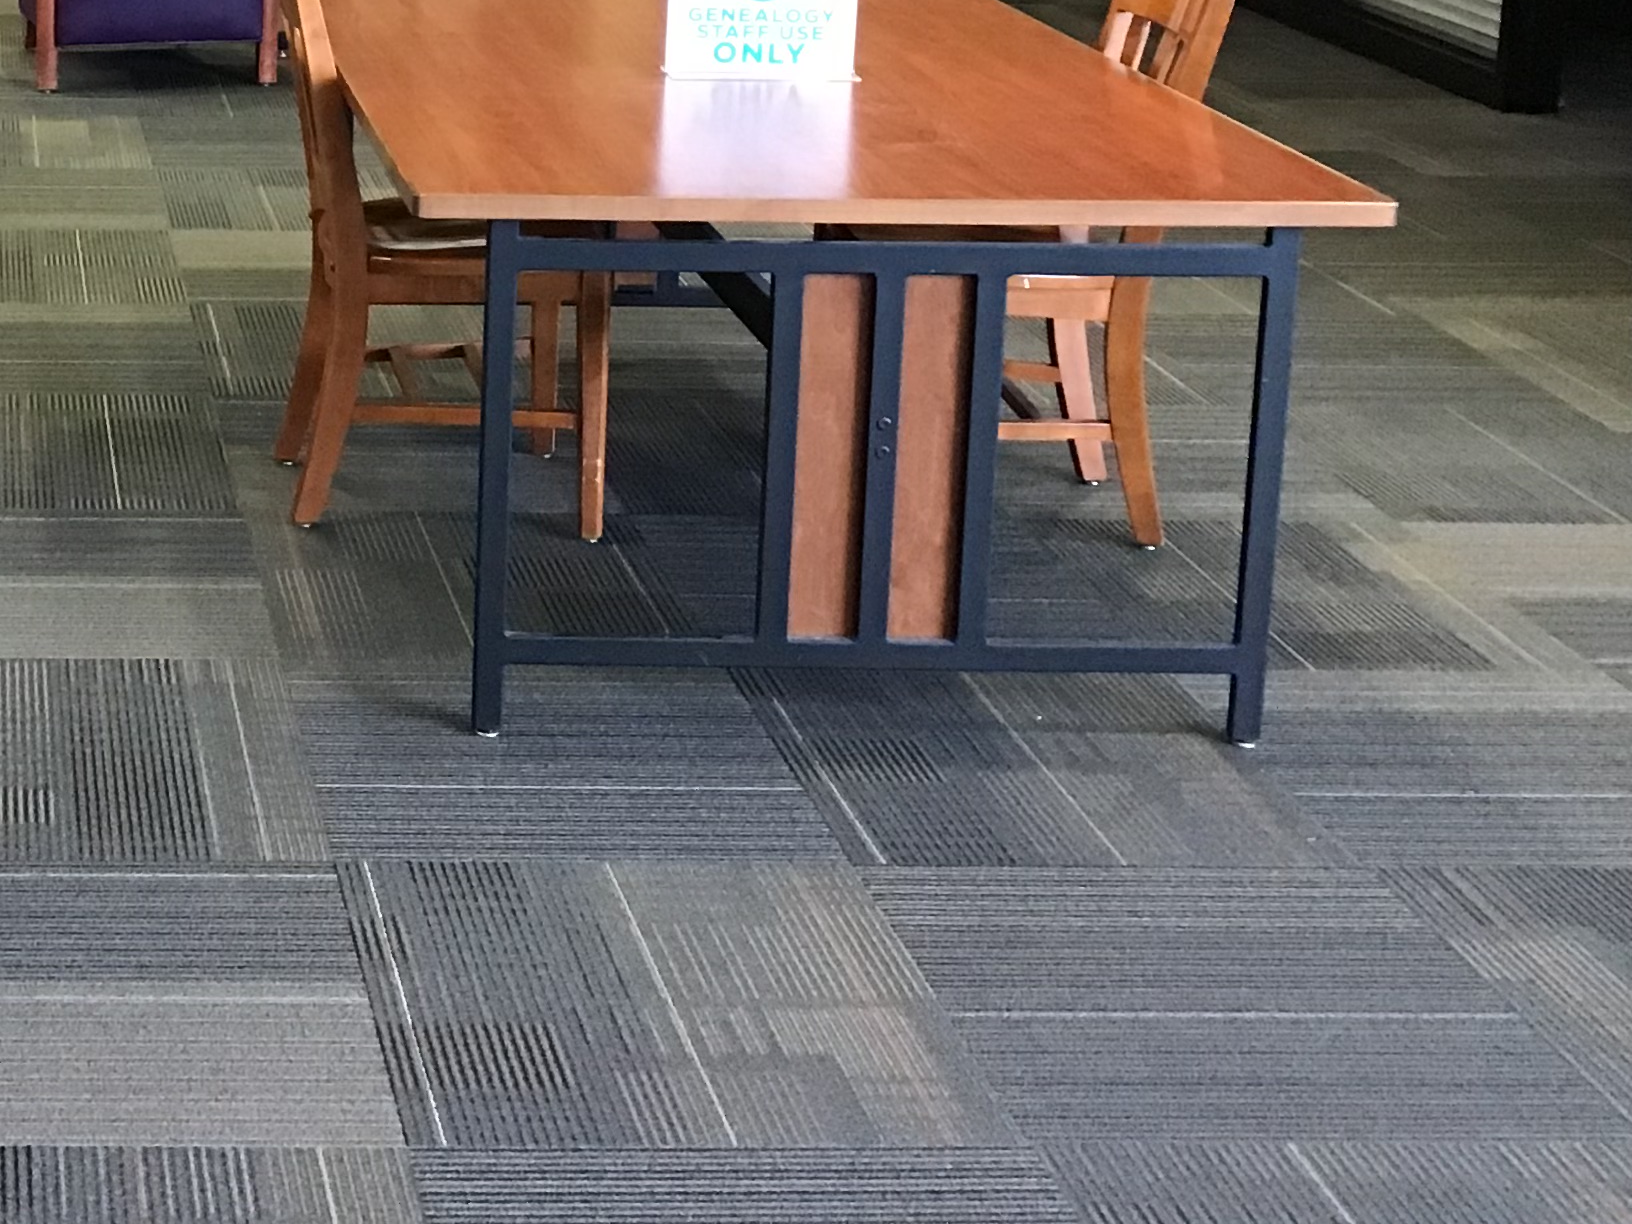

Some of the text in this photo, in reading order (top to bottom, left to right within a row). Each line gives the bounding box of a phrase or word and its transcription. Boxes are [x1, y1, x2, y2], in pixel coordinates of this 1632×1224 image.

[688, 7, 834, 23] GENEALOGY
[696, 24, 824, 41] STAFF USE
[713, 42, 805, 65] ONLY
